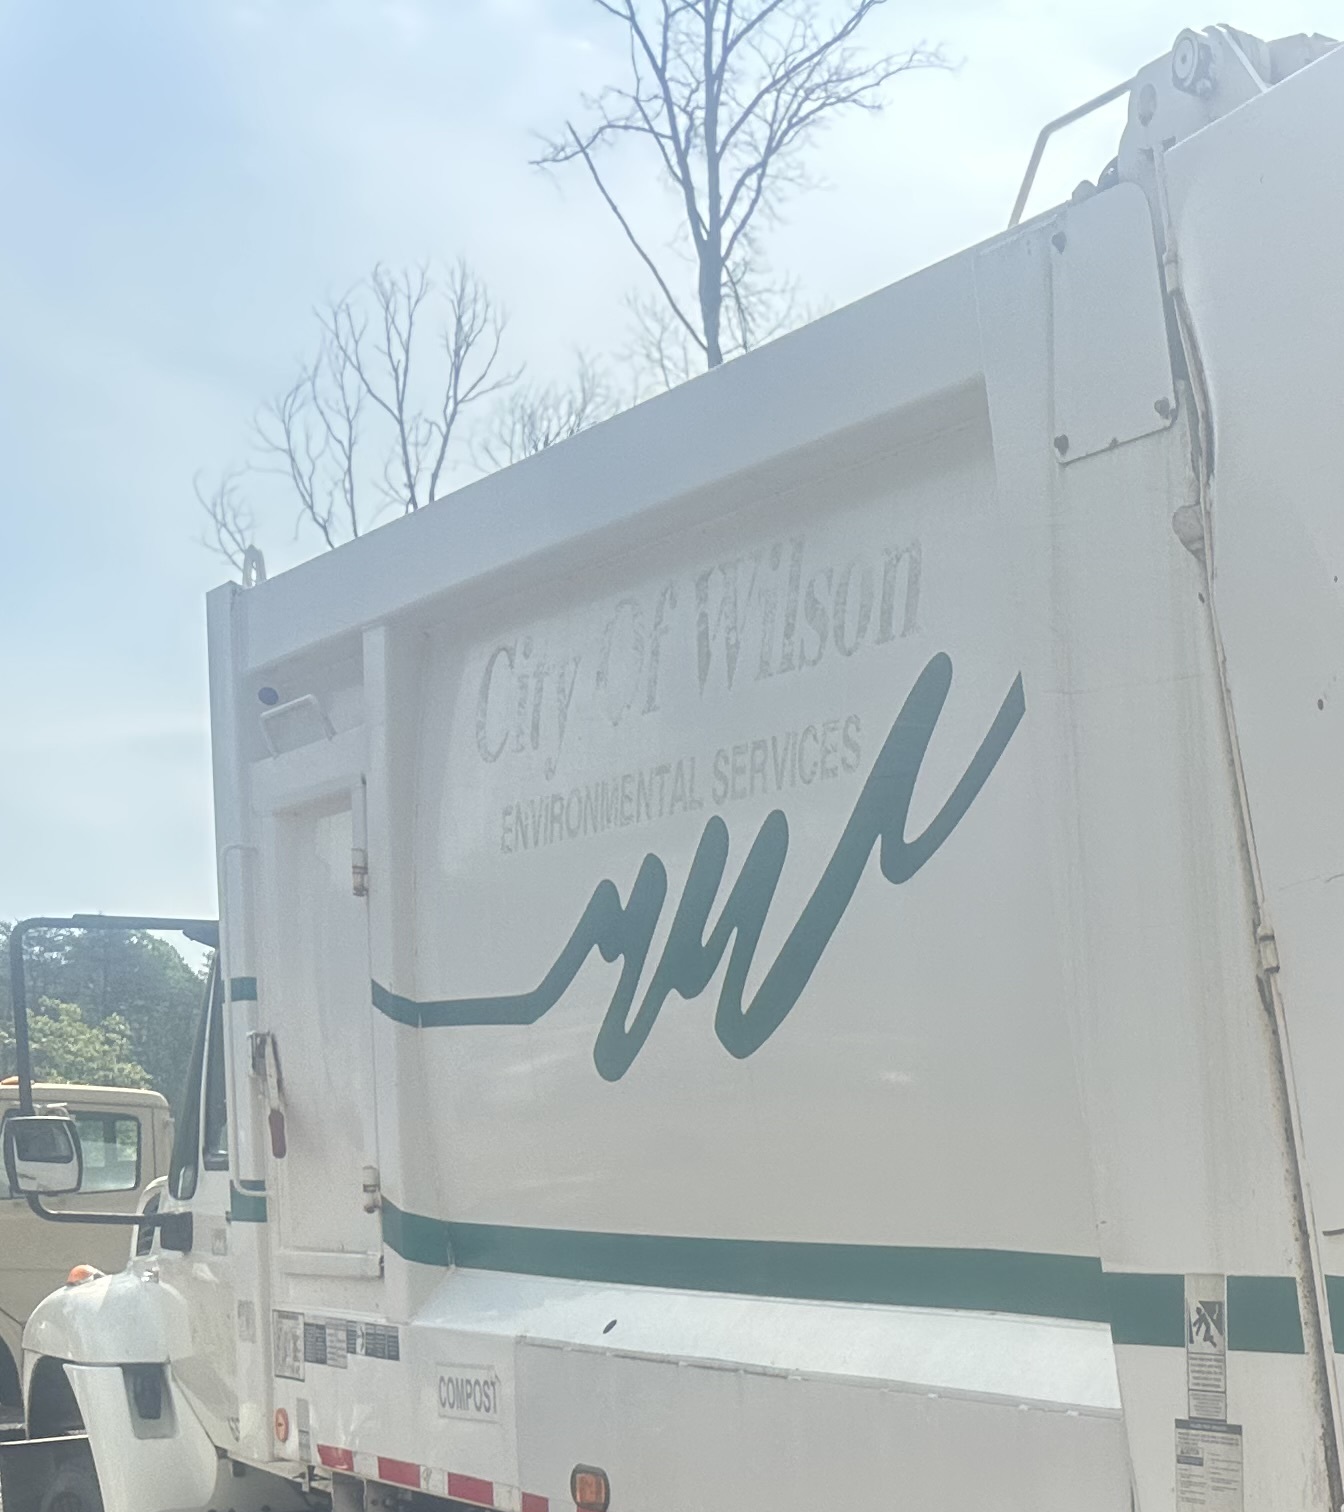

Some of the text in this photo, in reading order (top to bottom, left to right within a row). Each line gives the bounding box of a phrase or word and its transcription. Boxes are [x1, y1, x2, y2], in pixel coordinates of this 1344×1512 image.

[475, 634, 582, 781] City
[694, 537, 924, 698] Wilson
[499, 713, 862, 854] ENVIRONMENTAL SERVICES
[438, 1374, 498, 1415] COMPOST
